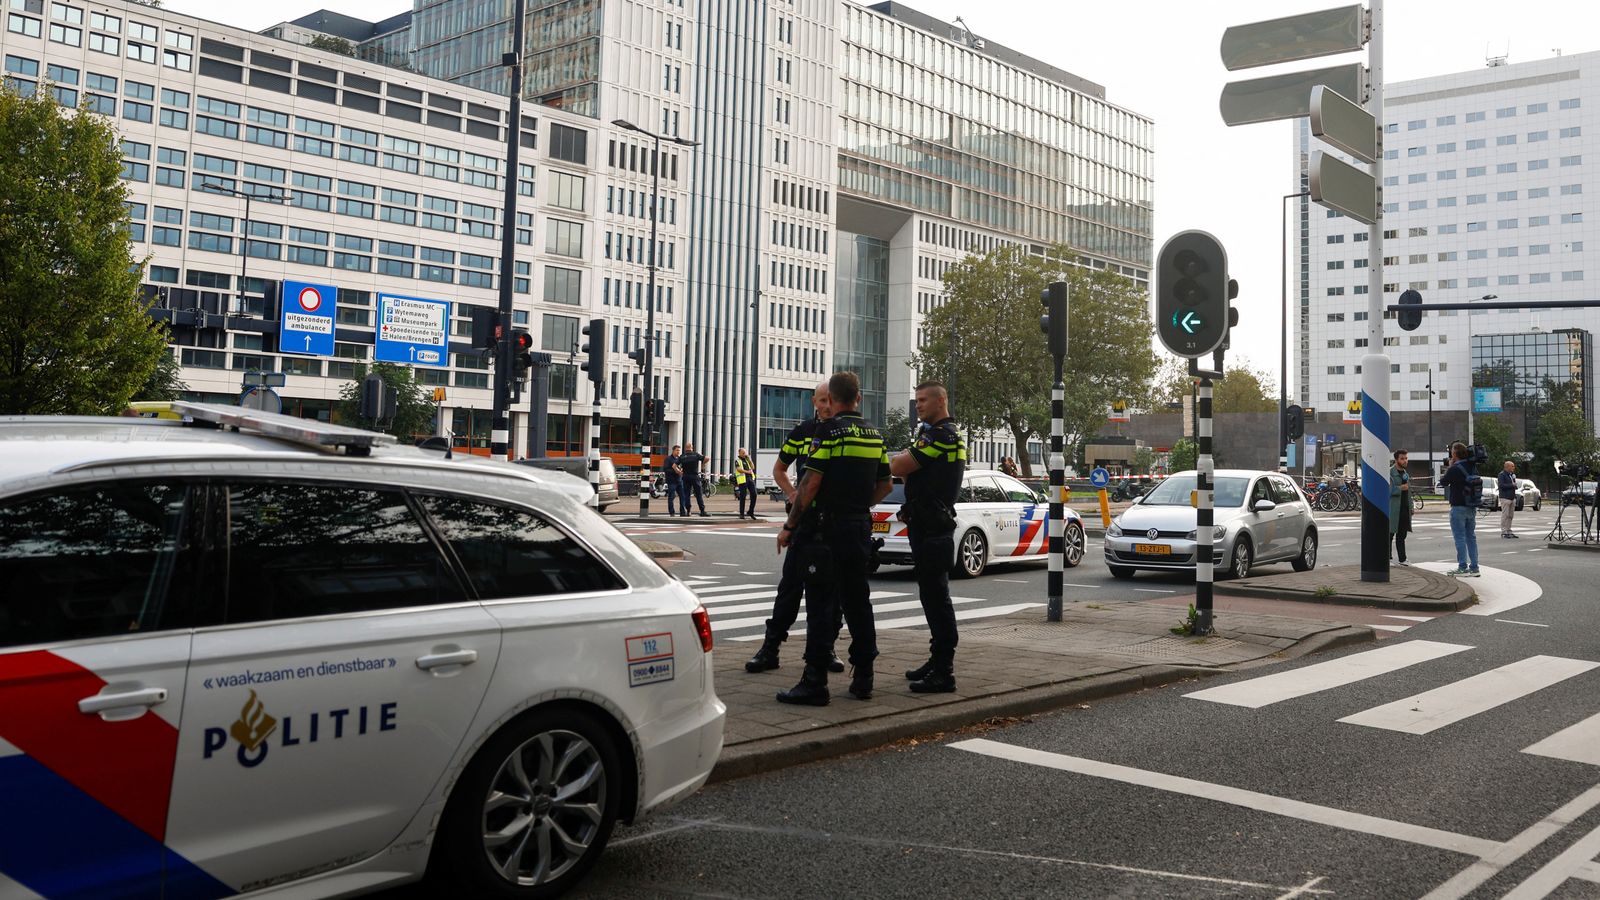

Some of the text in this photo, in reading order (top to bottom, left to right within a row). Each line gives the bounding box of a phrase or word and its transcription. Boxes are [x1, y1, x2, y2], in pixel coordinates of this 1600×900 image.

[401, 301, 425, 309] Erasmus
[395, 309, 429, 319] Wytemaweg
[287, 314, 331, 324] uitgezonderd
[401, 318, 437, 327] Museumpark
[291, 323, 326, 332] ambulance
[389, 326, 430, 335] Spoedeisende
[389, 334, 432, 343] Halen/Brengen
[643, 639, 657, 652] 112
[216, 670, 295, 688] waakzaam
[297, 666, 314, 679] en
[317, 657, 386, 677] dienstbaar
[202, 702, 397, 769] POLITIE
